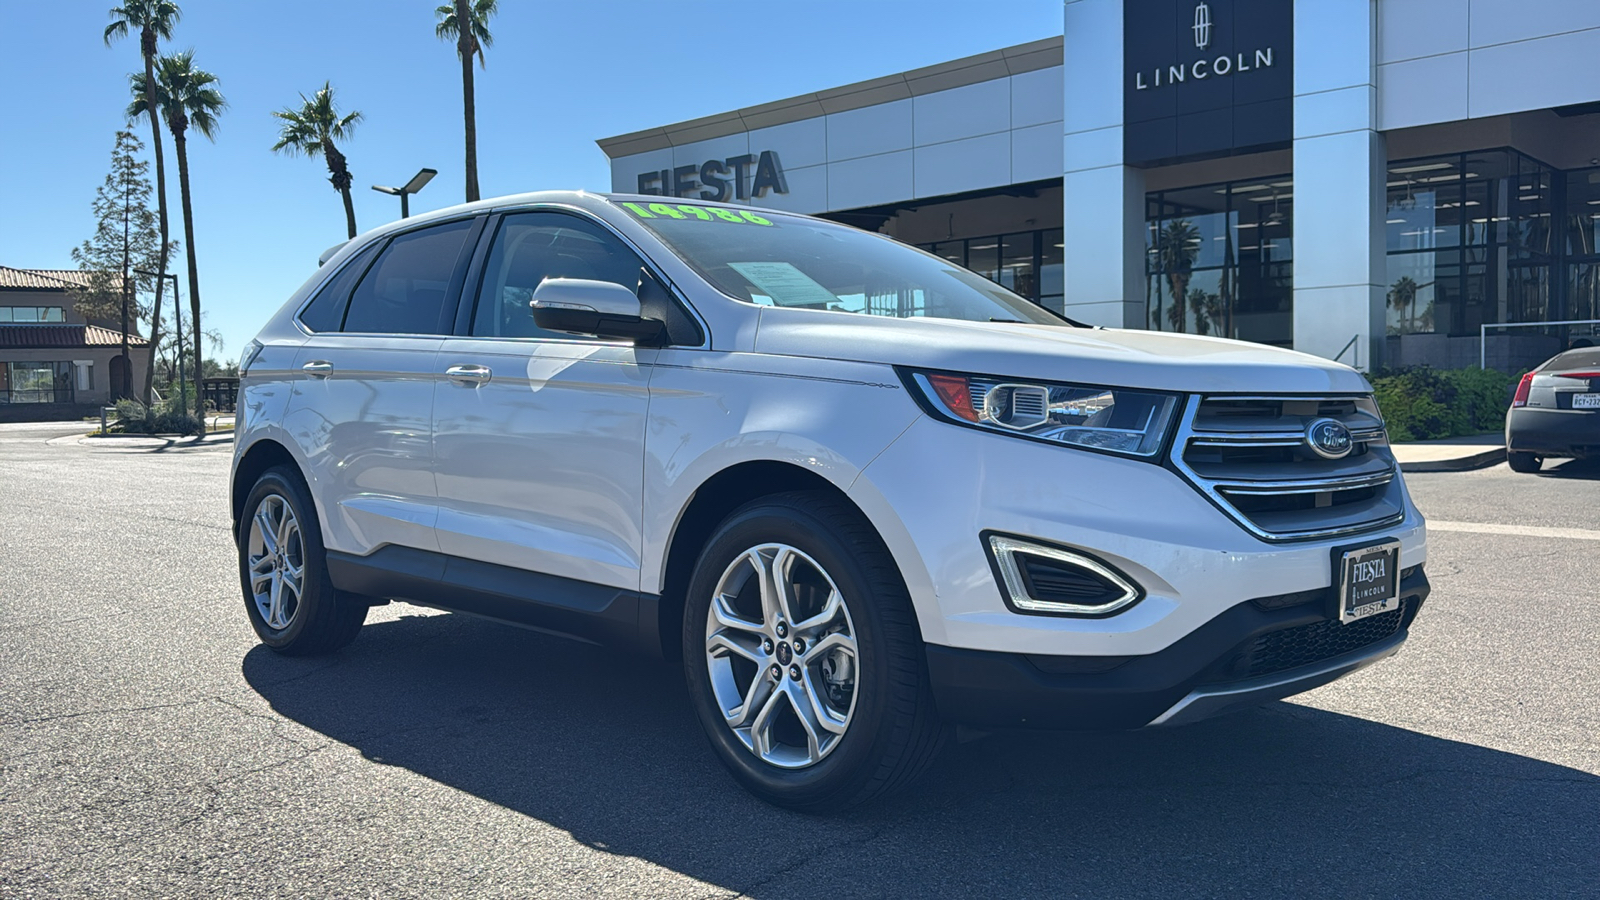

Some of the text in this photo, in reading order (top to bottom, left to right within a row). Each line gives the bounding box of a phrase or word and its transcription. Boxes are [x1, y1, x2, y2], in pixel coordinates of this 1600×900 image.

[1136, 48, 1272, 90] LINCOLN
[622, 202, 774, 227] 14986
[1323, 426, 1347, 447] Ford
[1352, 558, 1385, 583] FIESTA
[1357, 585, 1385, 599] LINCOLN
